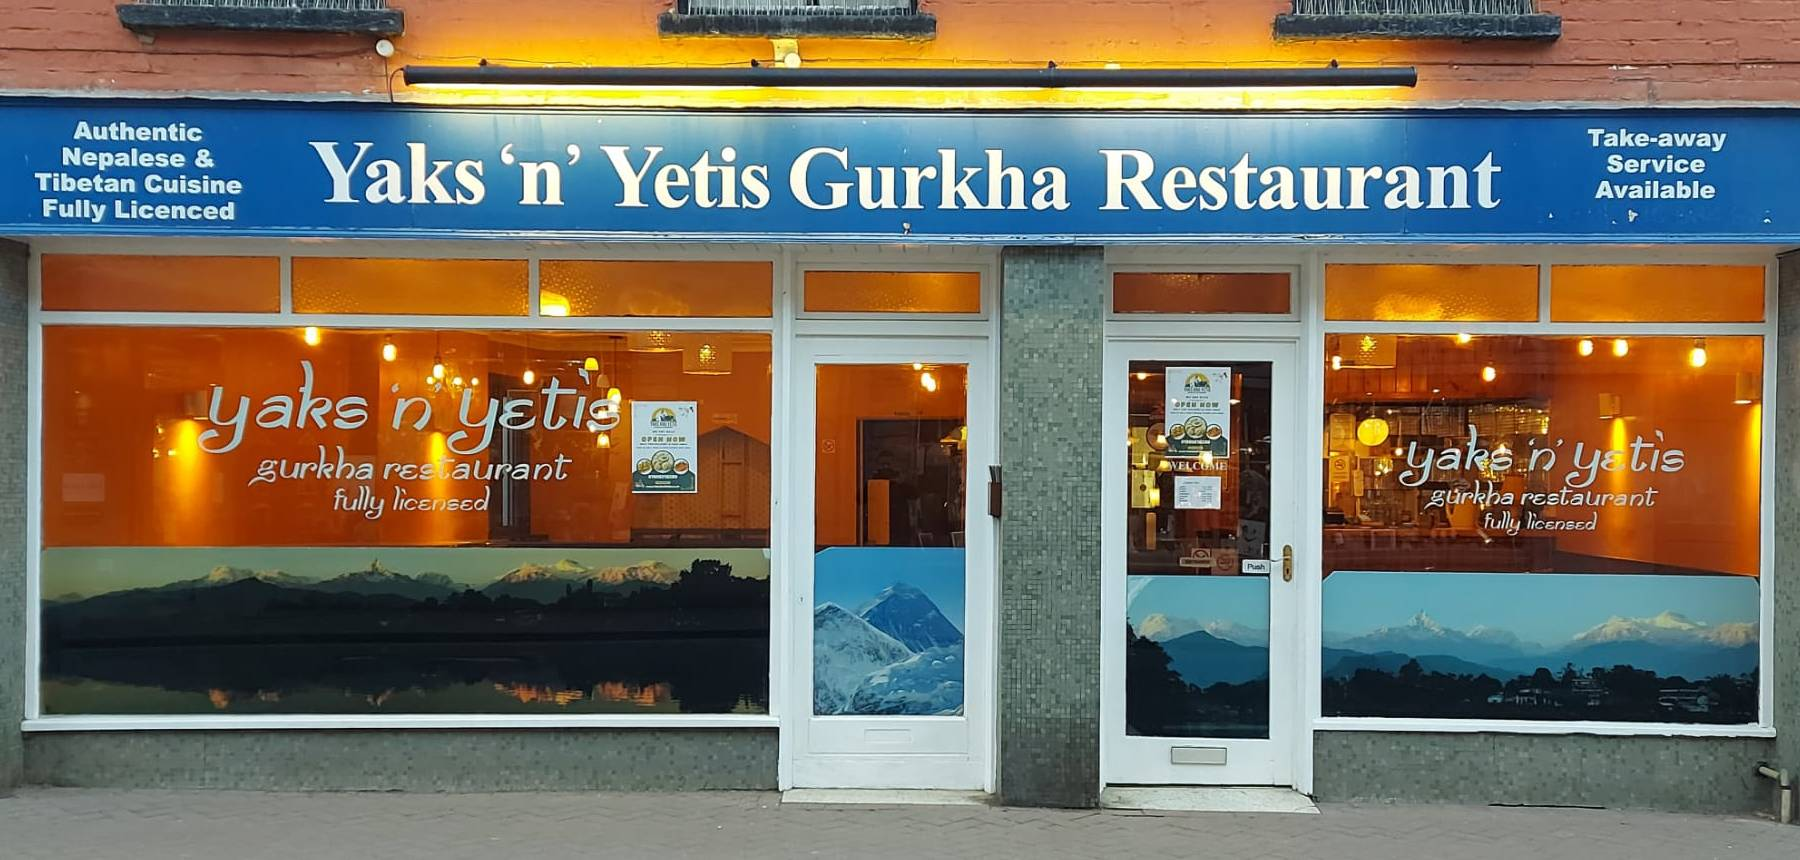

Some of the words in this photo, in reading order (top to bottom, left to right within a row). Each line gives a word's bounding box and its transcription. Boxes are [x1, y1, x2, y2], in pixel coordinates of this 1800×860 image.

[74, 121, 203, 142] Authentic
[1587, 128, 1727, 151] Take-away
[62, 147, 186, 170] Nepalese
[194, 148, 214, 168] &
[1607, 154, 1706, 174] Service
[34, 172, 136, 193] Tibetan
[144, 174, 243, 194] Cuisine
[309, 141, 486, 206] Yaks
[600, 146, 771, 209] Yetis
[789, 146, 1071, 211] Gurkha
[1098, 148, 1502, 211] Restaurant
[1595, 180, 1716, 199] Available
[42, 199, 106, 223] Fully
[115, 200, 235, 220] Licenced
[197, 360, 369, 453] yaks
[247, 445, 373, 487] gurkha
[383, 454, 573, 482] restaurant
[1169, 461, 1228, 471] WELCOME
[1398, 424, 1513, 487] yaks
[333, 485, 385, 520] fully
[393, 485, 491, 512] licensed
[1424, 480, 1513, 510] gurkha
[1520, 486, 1659, 507] restaurant
[1484, 511, 1520, 536] fully
[1526, 511, 1598, 531] licensed
[1247, 563, 1266, 571] Push
